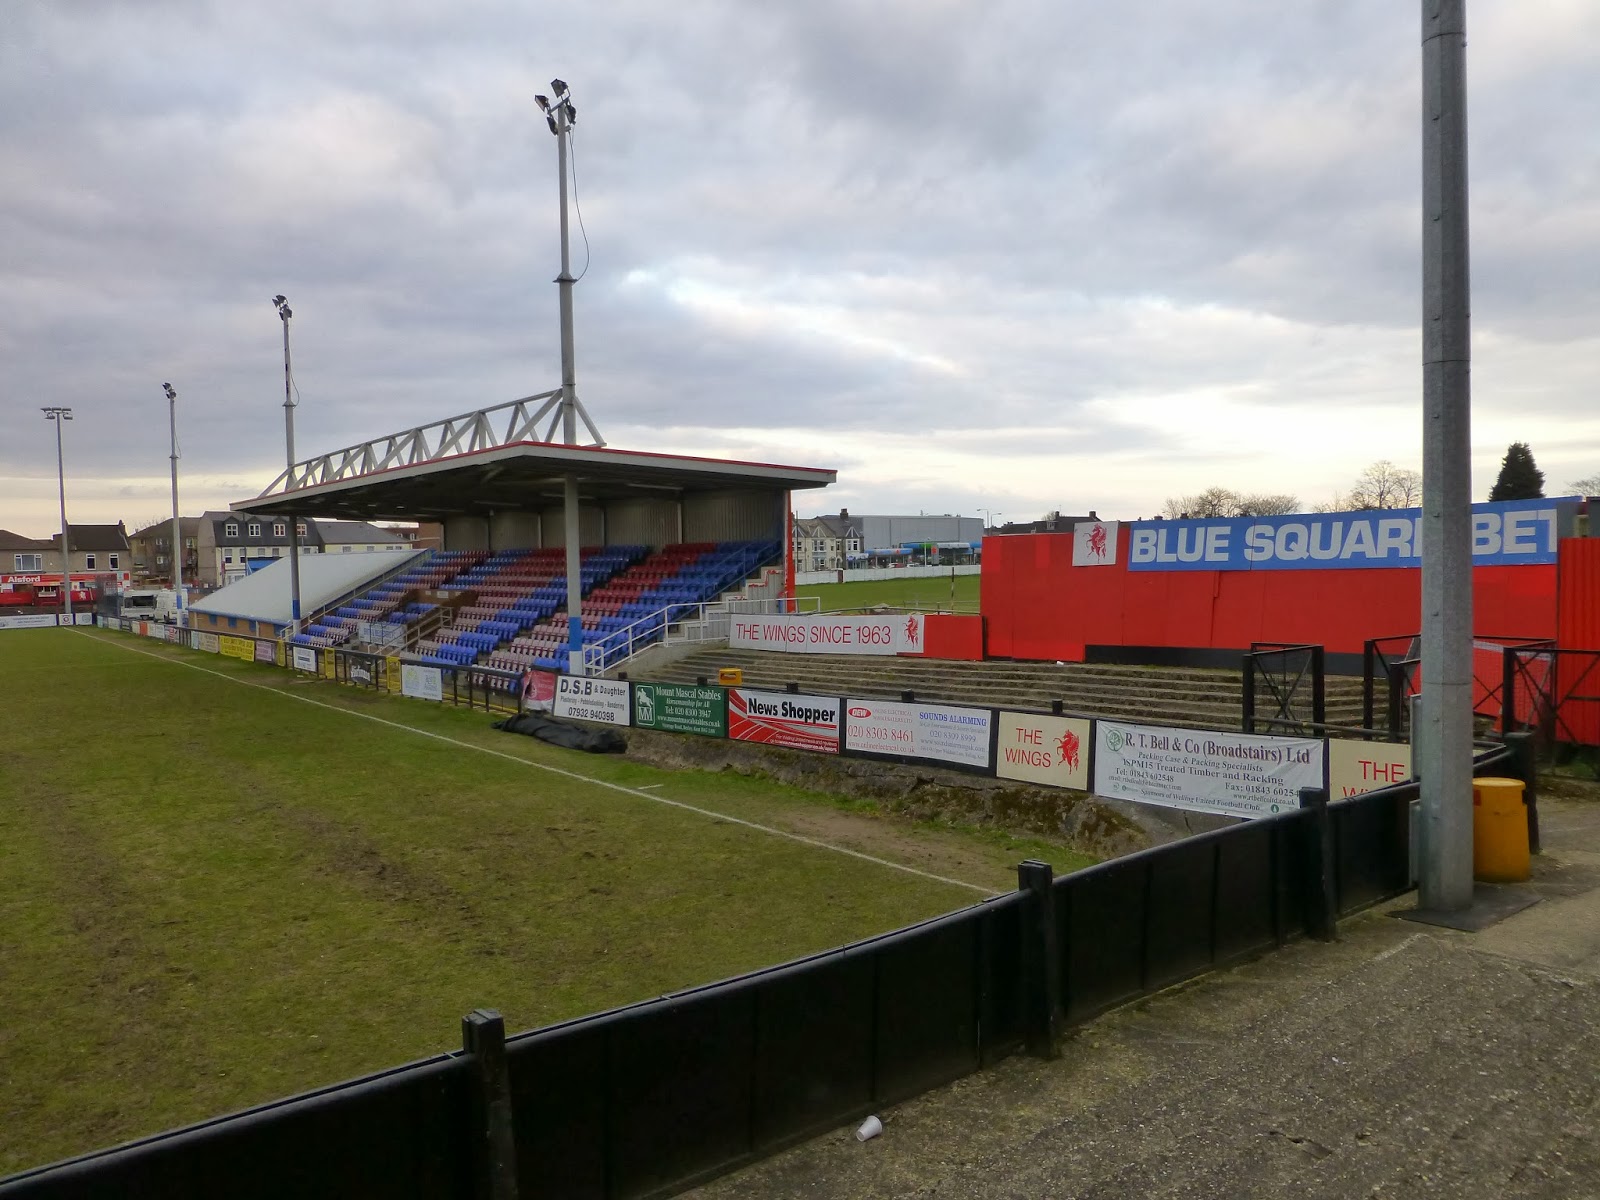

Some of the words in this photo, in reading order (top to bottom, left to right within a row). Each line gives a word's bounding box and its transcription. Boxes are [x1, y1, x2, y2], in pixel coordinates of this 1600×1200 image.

[1131, 526, 1232, 563] BLUE
[1244, 518, 1422, 562] SQUAR
[736, 623, 759, 640] THE
[763, 624, 806, 643] WINGS
[810, 625, 851, 644] SINCE
[856, 625, 890, 644] 1963
[560, 679, 592, 696] D.S.B
[594, 684, 598, 694] &
[600, 685, 626, 696] Daughter
[656, 687, 674, 696] Mount
[676, 688, 696, 698] Mascal
[698, 690, 721, 700] Stables
[568, 707, 588, 718] 07932
[748, 698, 778, 716] News
[782, 701, 835, 724] Shopper
[920, 712, 947, 722] SOUNDS
[949, 714, 986, 726] ALARMING
[848, 725, 864, 738] 020
[866, 727, 888, 740] 8303
[891, 729, 914, 742] 8461
[1016, 728, 1042, 745] THE
[1125, 732, 1135, 747] R.
[1138, 734, 1147, 748] T.
[1150, 735, 1169, 750] Bell
[1172, 737, 1181, 752] &
[1185, 738, 1200, 754] Co
[1203, 740, 1281, 765] (Broadstairs)
[1286, 747, 1310, 764] Ltd
[1005, 747, 1051, 768] WINGS
[1138, 752, 1164, 760] Packing
[1165, 754, 1181, 763] Case
[1182, 756, 1188, 764] &
[1191, 758, 1220, 769] Packing
[1222, 761, 1263, 772] Specialists
[1116, 768, 1128, 776] Tel:
[1130, 770, 1148, 779] 01843
[1150, 772, 1174, 782] 602548
[1123, 758, 1154, 769] ISPM15
[1156, 763, 1185, 774] Treated
[1188, 766, 1220, 778] Timber
[1223, 770, 1240, 780] and
[1243, 773, 1284, 786] Racking
[1358, 760, 1404, 783] THE
[1225, 782, 1243, 792] Fax:
[1246, 785, 1271, 795] 01843
[1274, 788, 1300, 798] 60254
[1217, 798, 1242, 809] Football
[1244, 801, 1260, 811] Club
